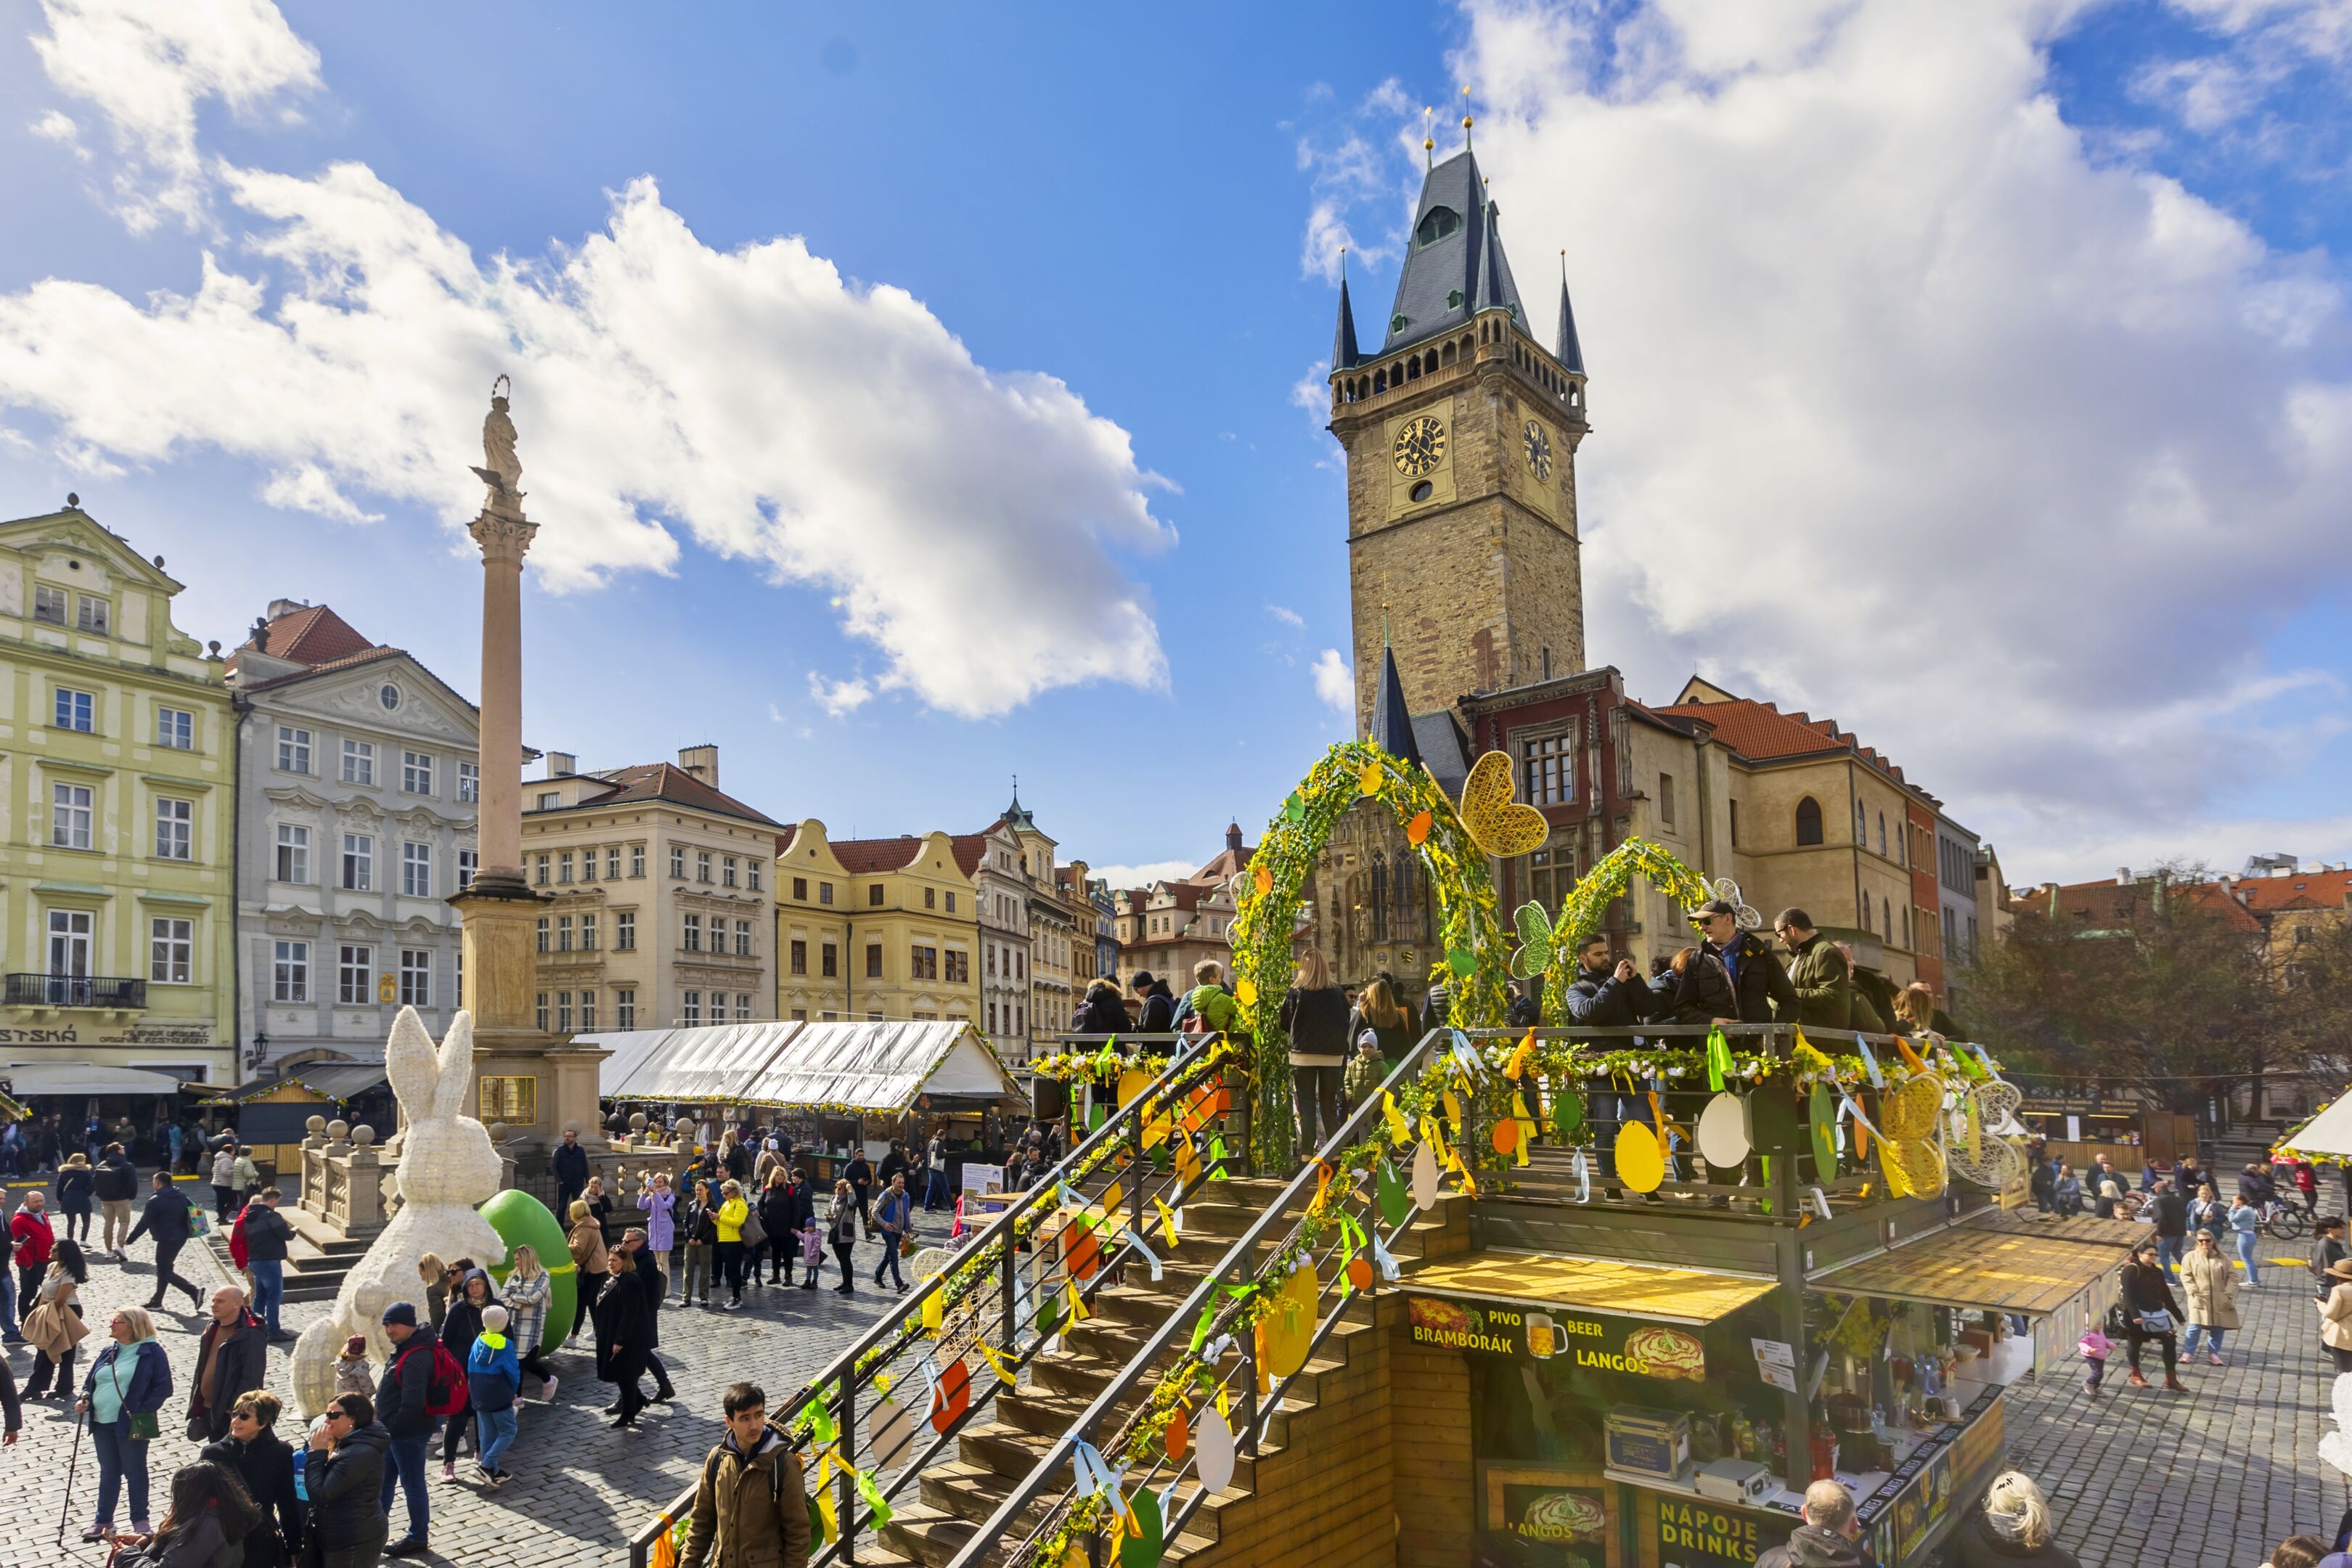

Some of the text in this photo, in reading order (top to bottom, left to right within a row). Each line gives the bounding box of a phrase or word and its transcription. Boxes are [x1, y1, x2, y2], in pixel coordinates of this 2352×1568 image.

[1489, 1310, 1522, 1326] PIVO
[1567, 1320, 1604, 1337] BEER
[1414, 1326, 1514, 1354] BRAMBORÁK
[1577, 1349, 1650, 1374] LANGOS
[1661, 1502, 1757, 1542] NÁPOJE
[1662, 1524, 1757, 1563] DRINKS
